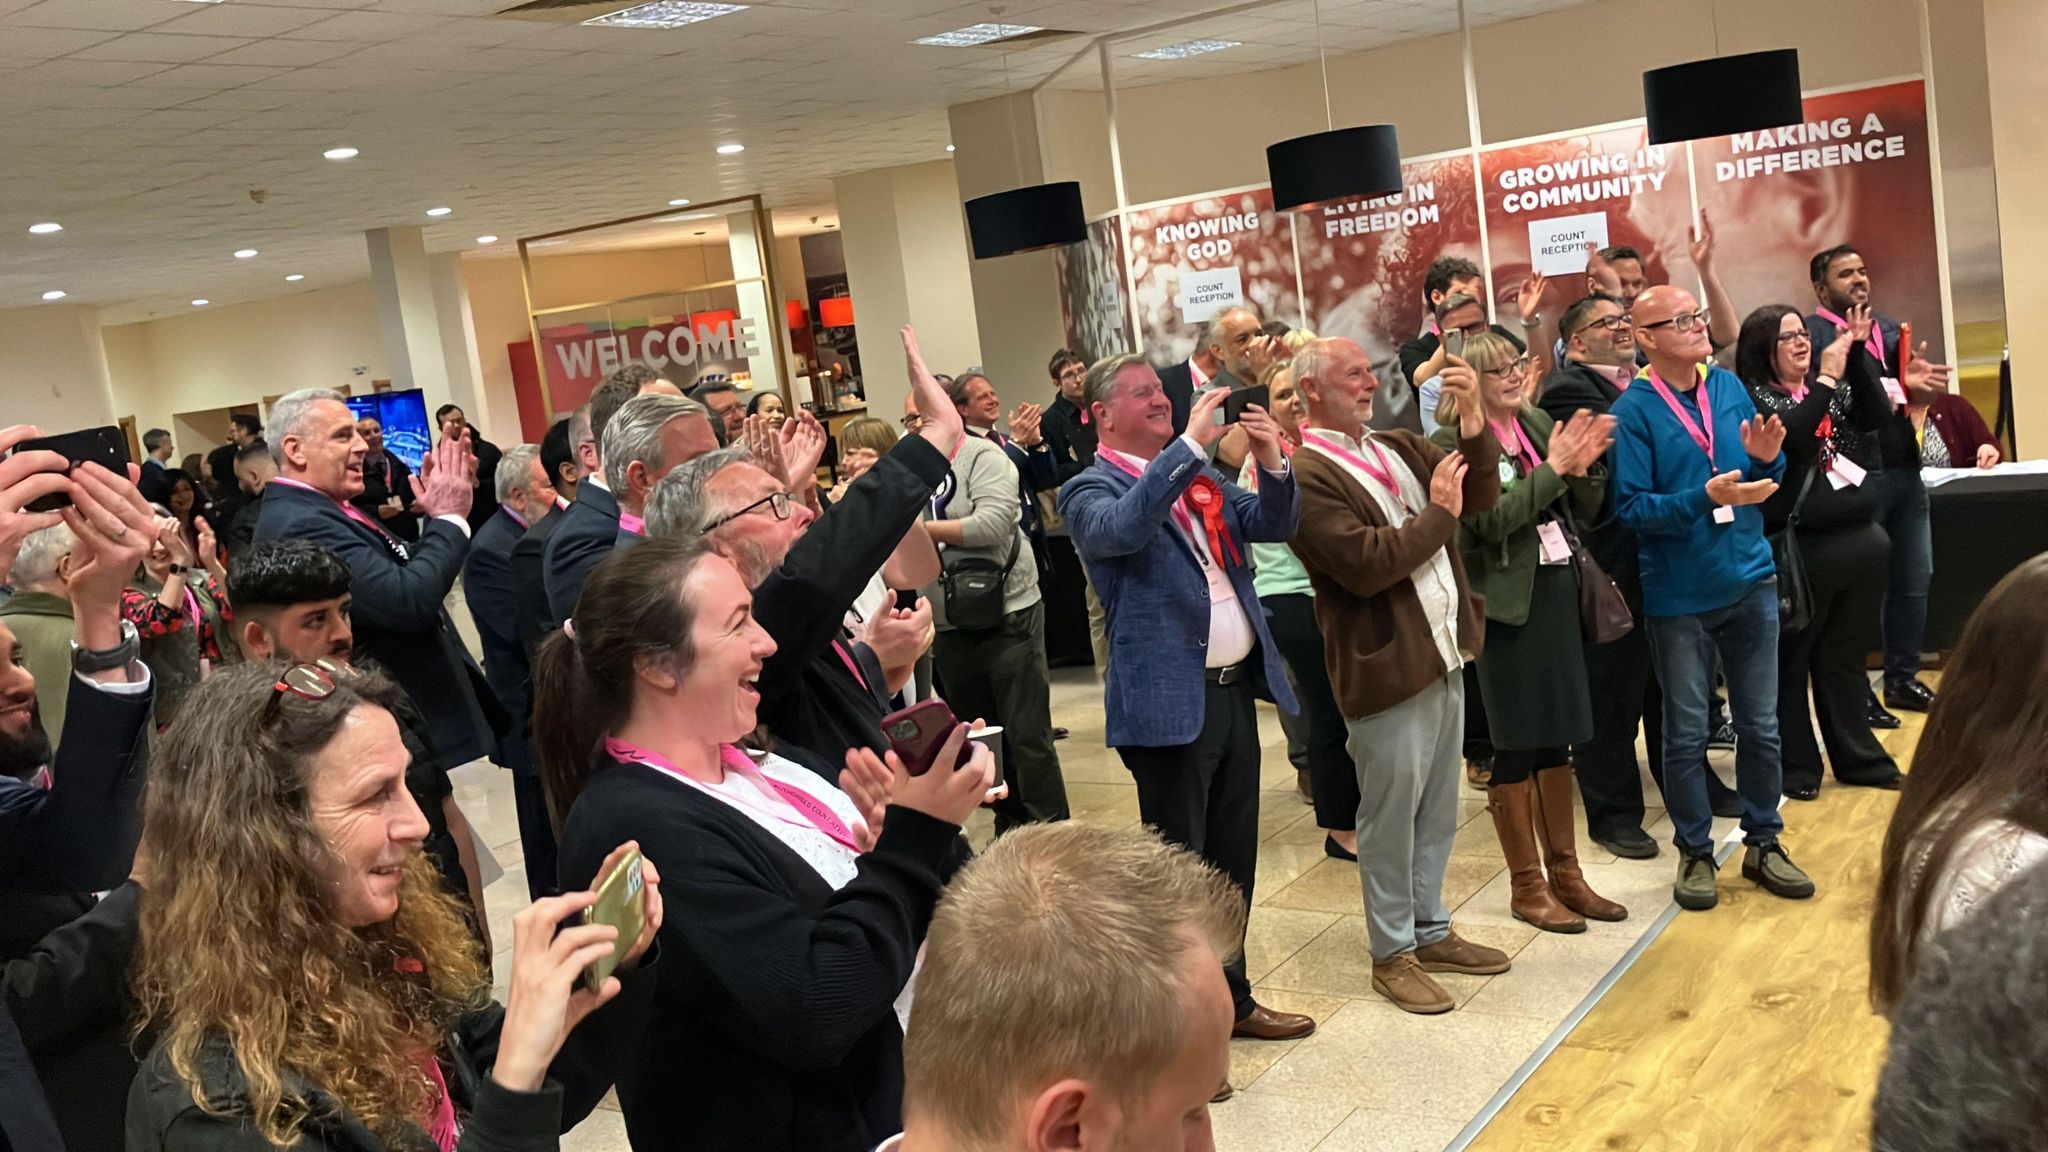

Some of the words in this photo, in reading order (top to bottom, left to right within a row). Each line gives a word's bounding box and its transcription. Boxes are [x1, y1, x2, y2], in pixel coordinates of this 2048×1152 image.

[1731, 117, 1851, 154] MAKING
[1860, 112, 1885, 136] A
[1499, 153, 1629, 190] GROWING
[1636, 145, 1666, 170] IN
[1715, 135, 1905, 182] DIFFERENCE
[1407, 181, 1435, 203] IN
[1502, 171, 1667, 214] COMMUNITY
[1155, 212, 1260, 245] KNOWING
[1325, 204, 1440, 239] FREEDOM
[1550, 230, 1586, 243] COUNT
[1186, 239, 1233, 261] GOD
[1541, 241, 1598, 256] RECEPTION
[1189, 291, 1235, 305] RECEPTION
[1196, 282, 1224, 294] COUNT
[556, 317, 760, 380] WELCOME
